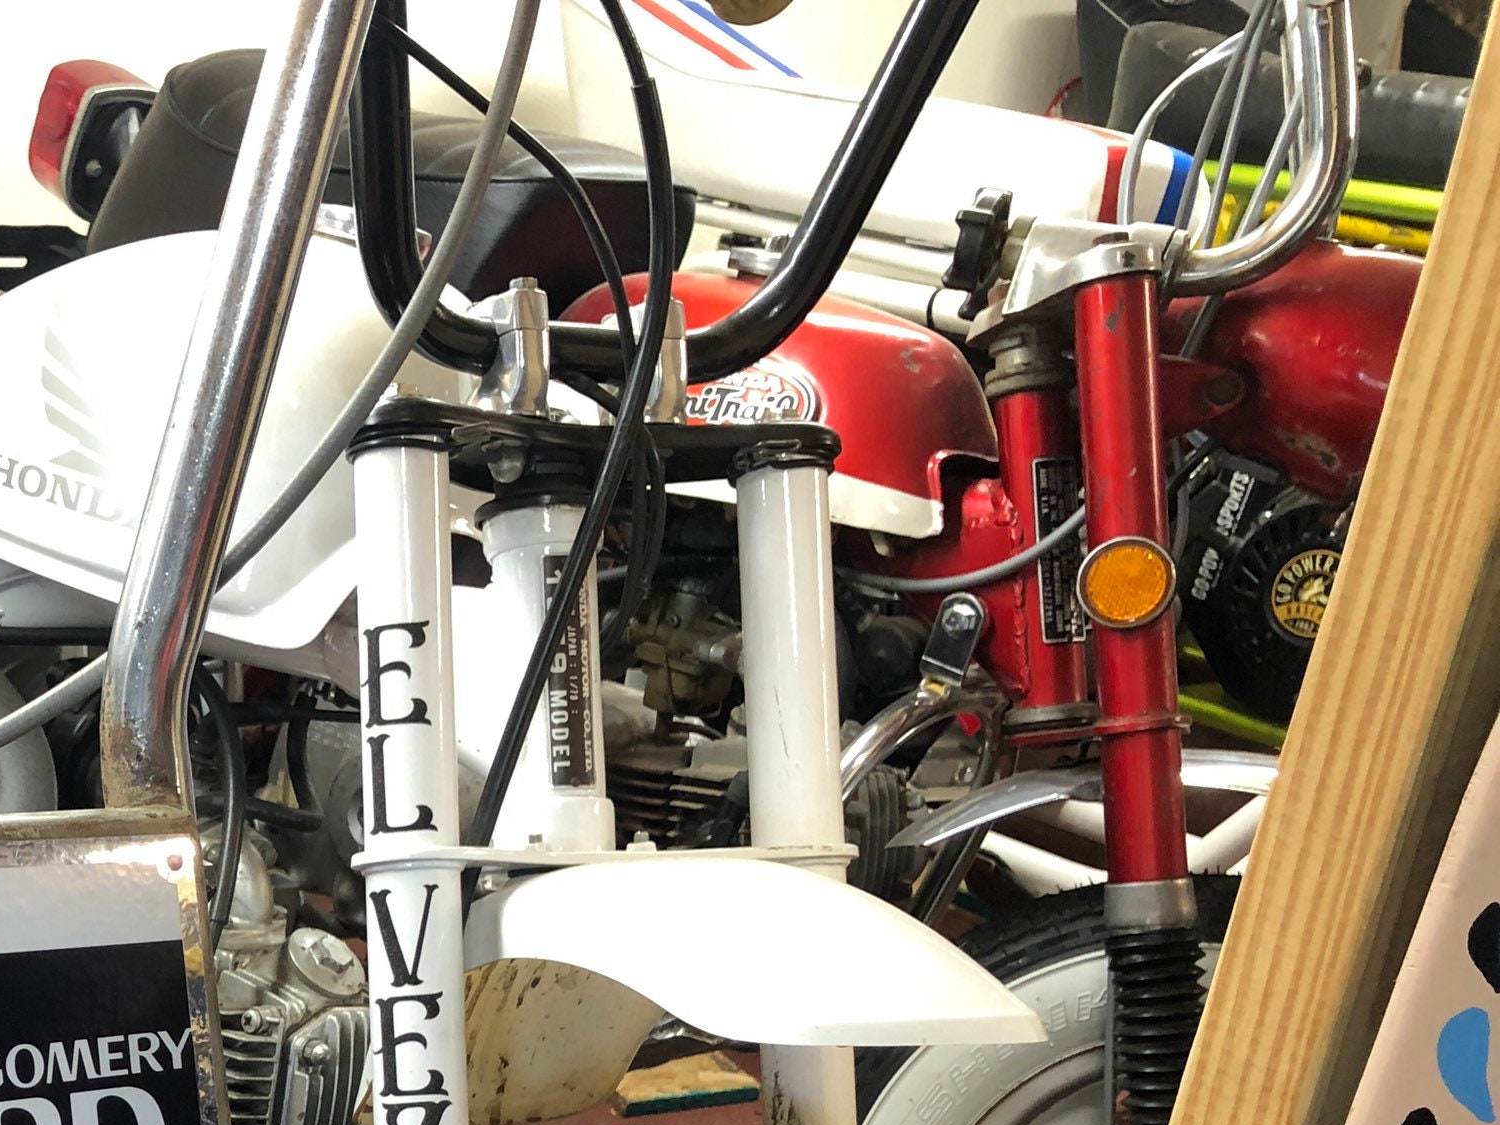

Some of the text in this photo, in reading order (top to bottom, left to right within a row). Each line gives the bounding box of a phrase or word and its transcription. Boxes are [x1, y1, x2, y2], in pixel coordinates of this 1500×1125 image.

[567, 625, 577, 657] JAPAN
[581, 639, 590, 700] MOTOR
[550, 689, 572, 774] MODEL
